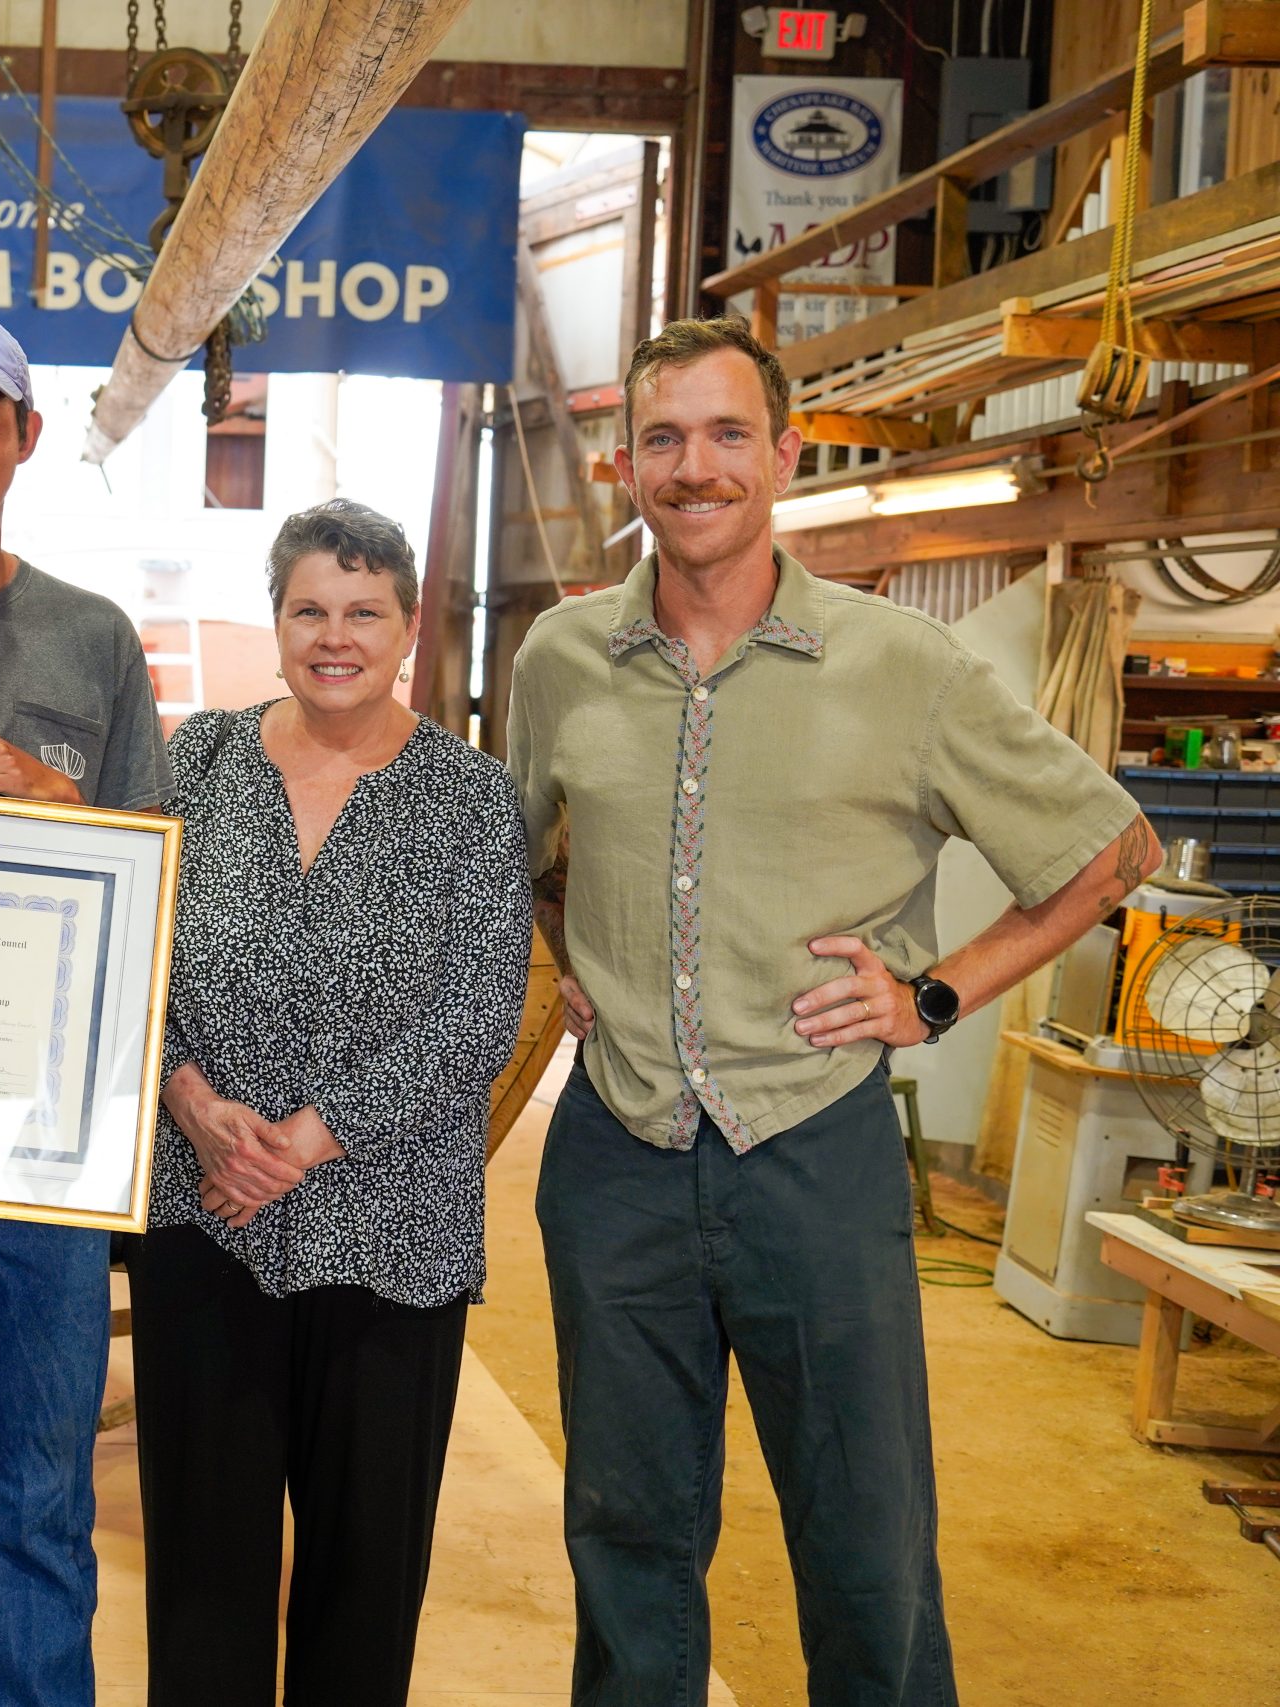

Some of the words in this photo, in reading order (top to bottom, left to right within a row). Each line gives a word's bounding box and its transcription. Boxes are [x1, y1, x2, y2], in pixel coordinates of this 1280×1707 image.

[778, 10, 829, 50] EXIT
[766, 190, 813, 206] Thank
[818, 195, 849, 211] you
[35, 252, 450, 323] BOSHOP
